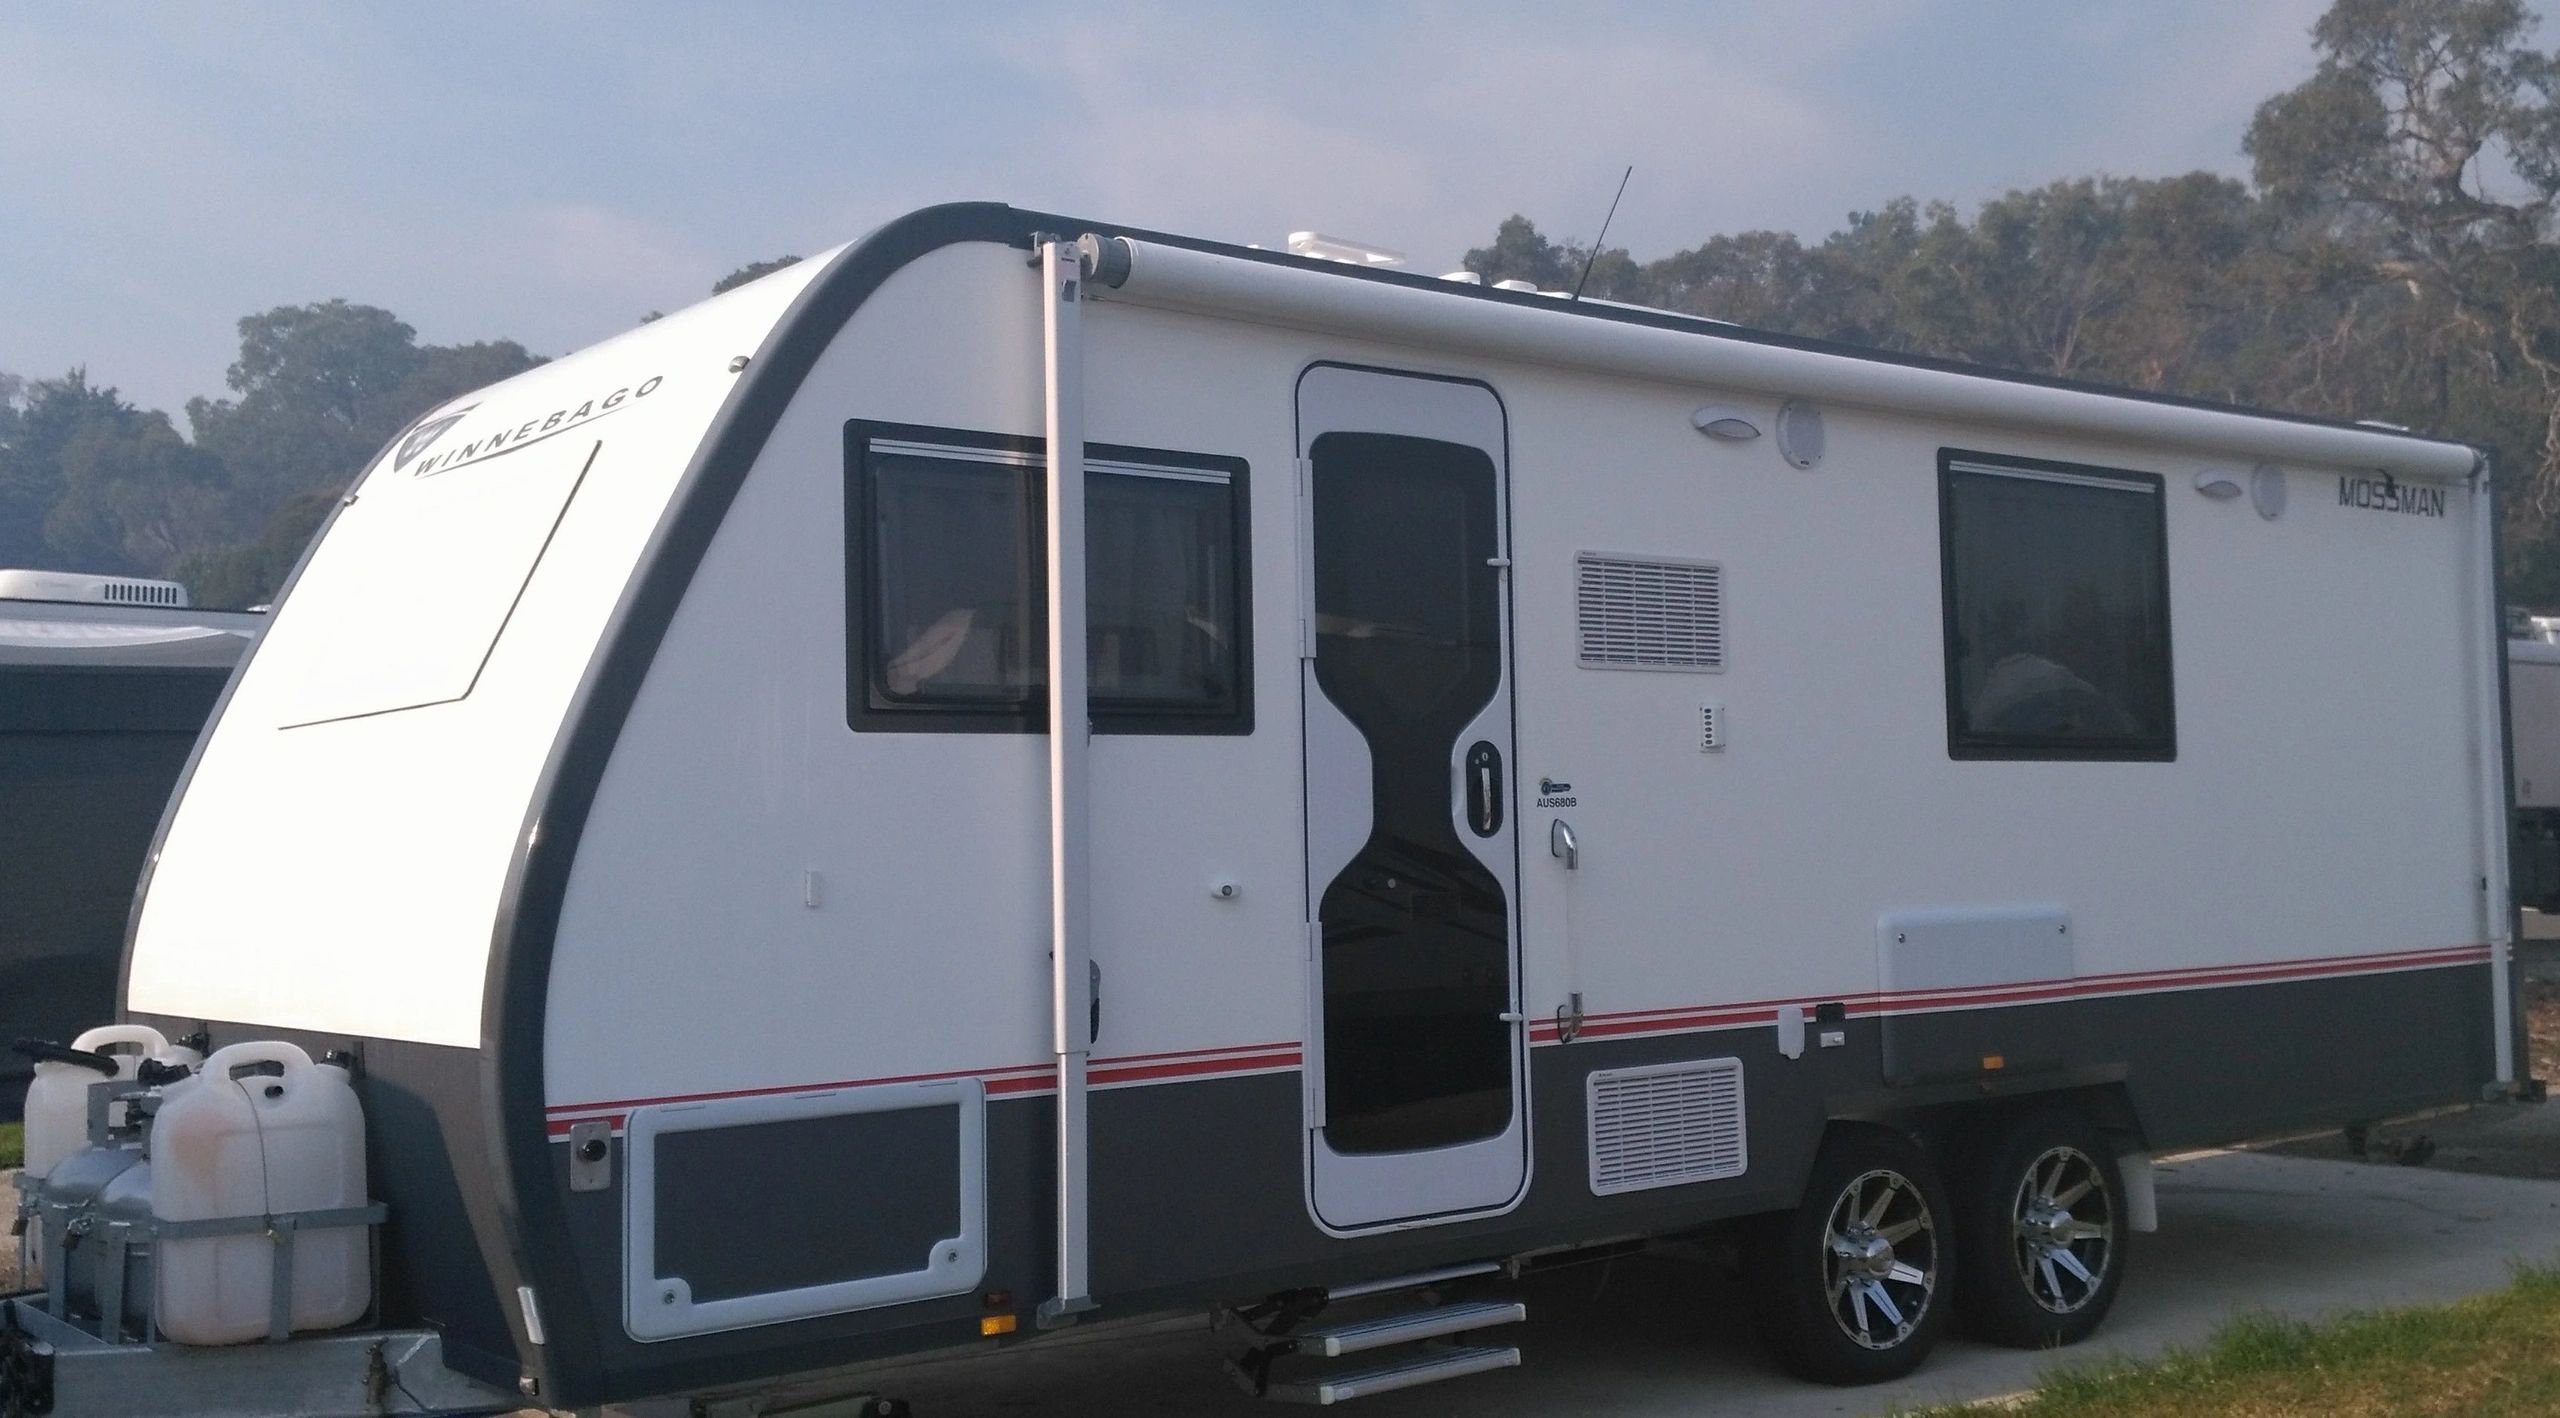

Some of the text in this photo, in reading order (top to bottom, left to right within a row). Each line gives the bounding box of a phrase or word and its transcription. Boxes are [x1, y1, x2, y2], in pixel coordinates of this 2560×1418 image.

[414, 375, 664, 477] WINNEBAGO
[2338, 476, 2445, 518] MOSSMAN
[1536, 796, 1577, 808] AUS680B
